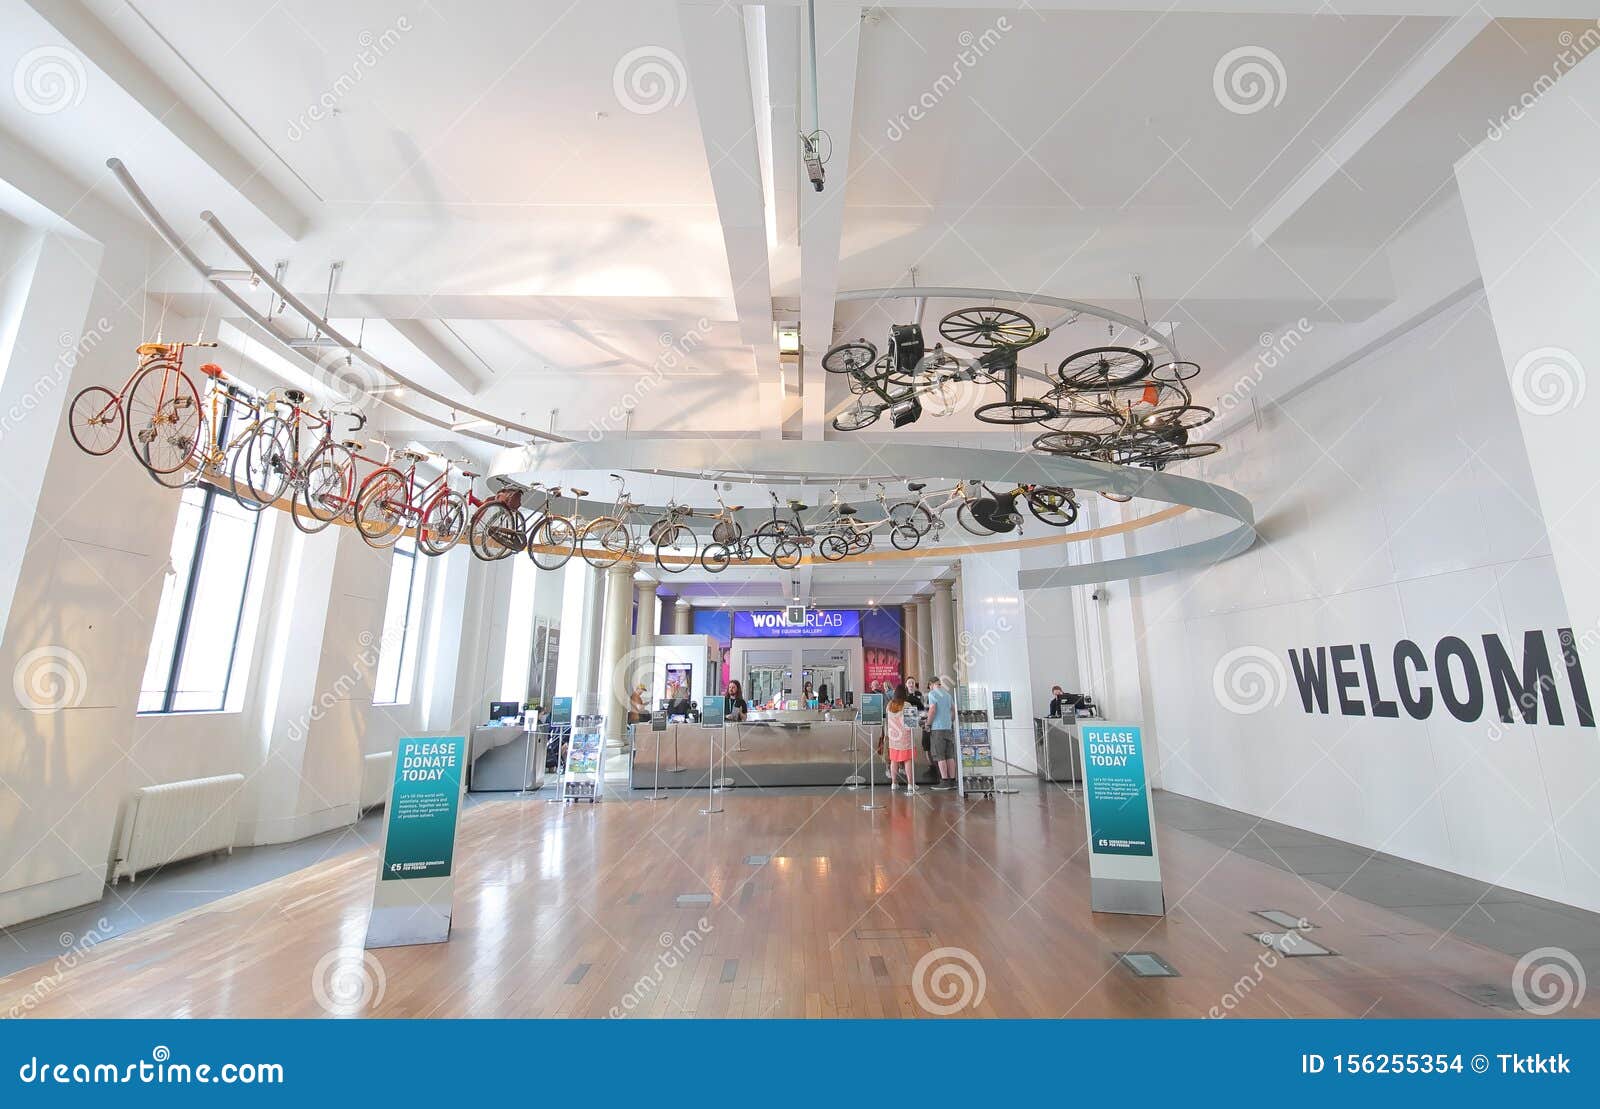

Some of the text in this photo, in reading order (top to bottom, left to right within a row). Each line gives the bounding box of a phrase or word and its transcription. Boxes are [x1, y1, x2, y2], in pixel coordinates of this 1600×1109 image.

[751, 613, 843, 628] WONRLAB
[1089, 732, 1134, 743] PLEASE
[405, 743, 456, 756] PLEASE
[1089, 743, 1136, 755] DONATE
[403, 756, 456, 769] DONATE
[1090, 755, 1128, 767] TODAY
[402, 768, 445, 781] TODAY
[1098, 839, 1109, 847] £5
[391, 863, 402, 872] £5
